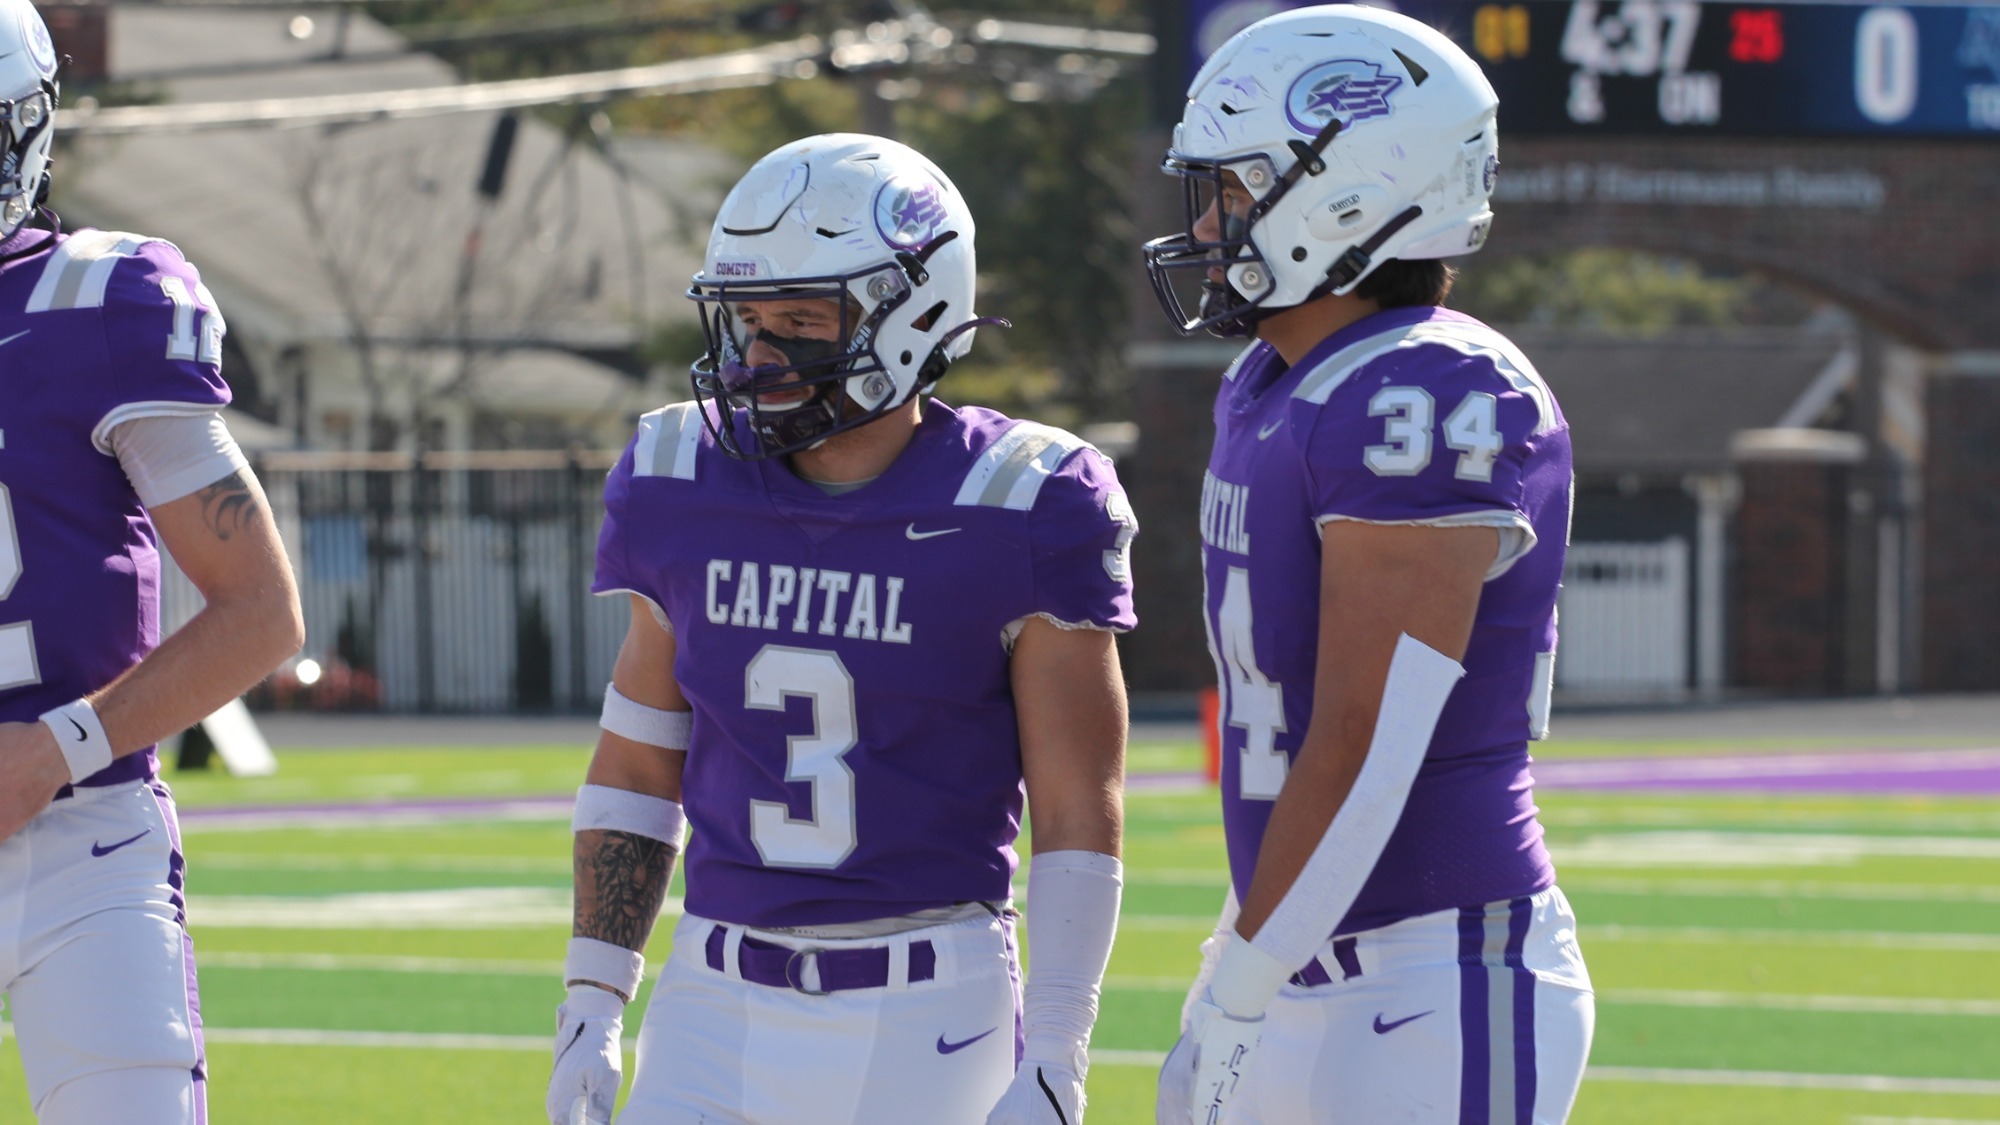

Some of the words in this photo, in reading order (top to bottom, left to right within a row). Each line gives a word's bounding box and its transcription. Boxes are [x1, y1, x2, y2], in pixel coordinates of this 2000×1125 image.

[1854, 7, 1919, 126] 0
[716, 262, 756, 276] COMETS
[1363, 385, 1503, 483] 34
[706, 558, 912, 645] CAPITAL
[1203, 548, 1289, 800] 4
[743, 643, 858, 870] 3
